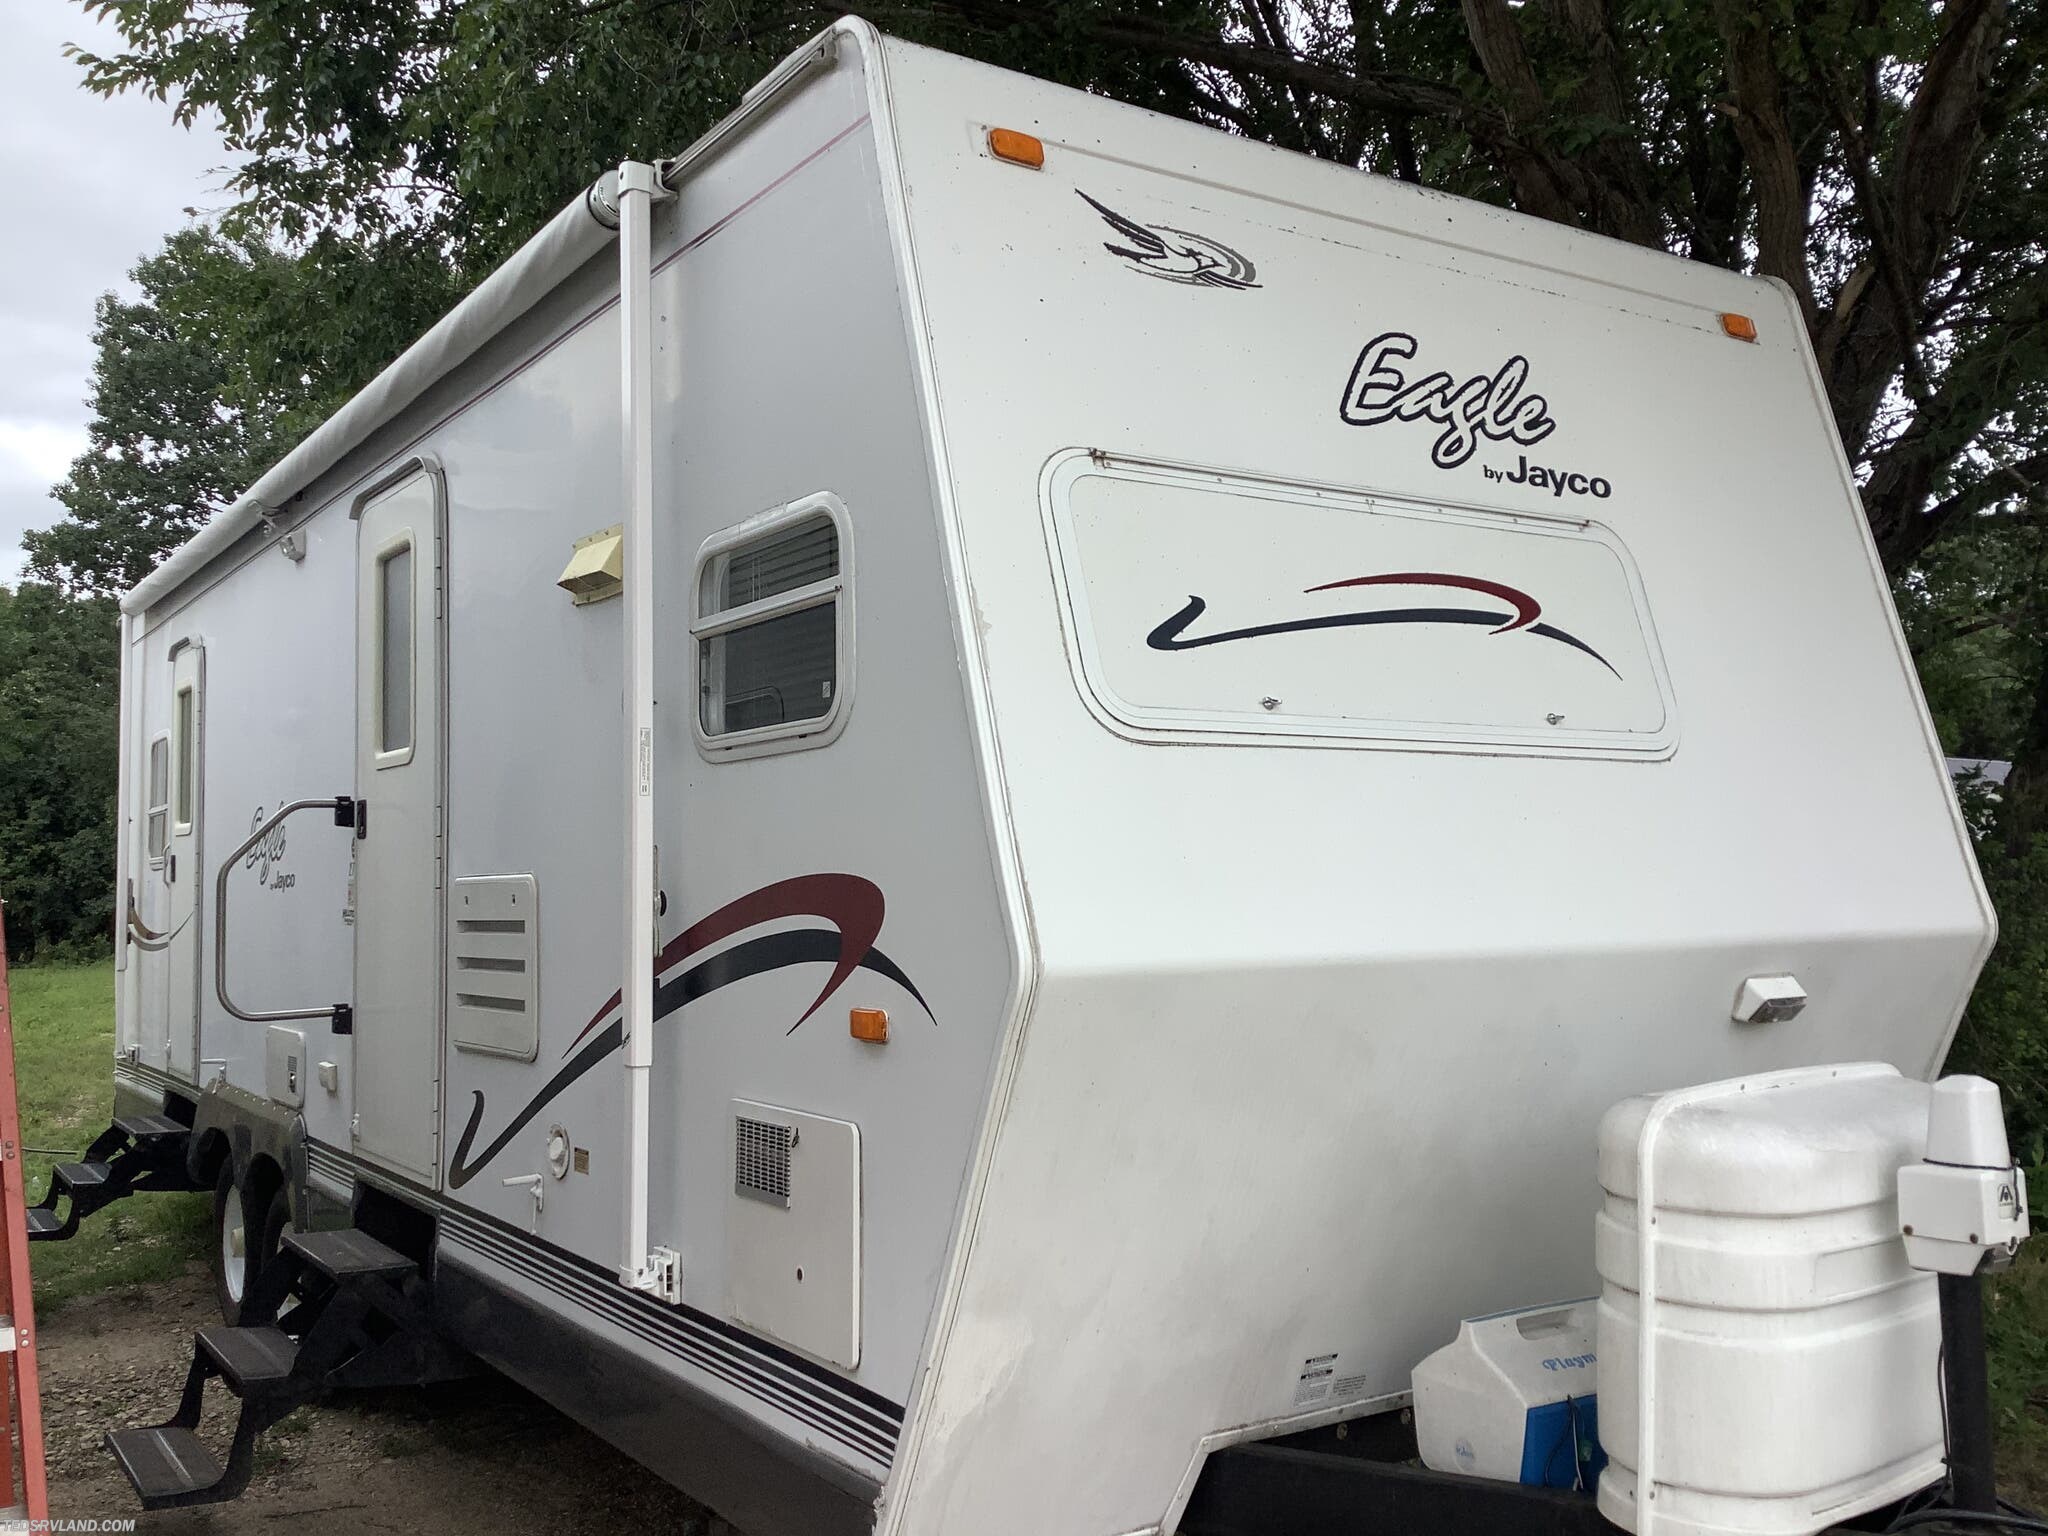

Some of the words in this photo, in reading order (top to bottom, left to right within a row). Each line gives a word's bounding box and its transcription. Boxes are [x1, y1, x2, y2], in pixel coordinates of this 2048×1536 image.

[1340, 332, 1556, 469] Eagle
[1482, 464, 1504, 484] by
[1506, 455, 1612, 498] Jayco
